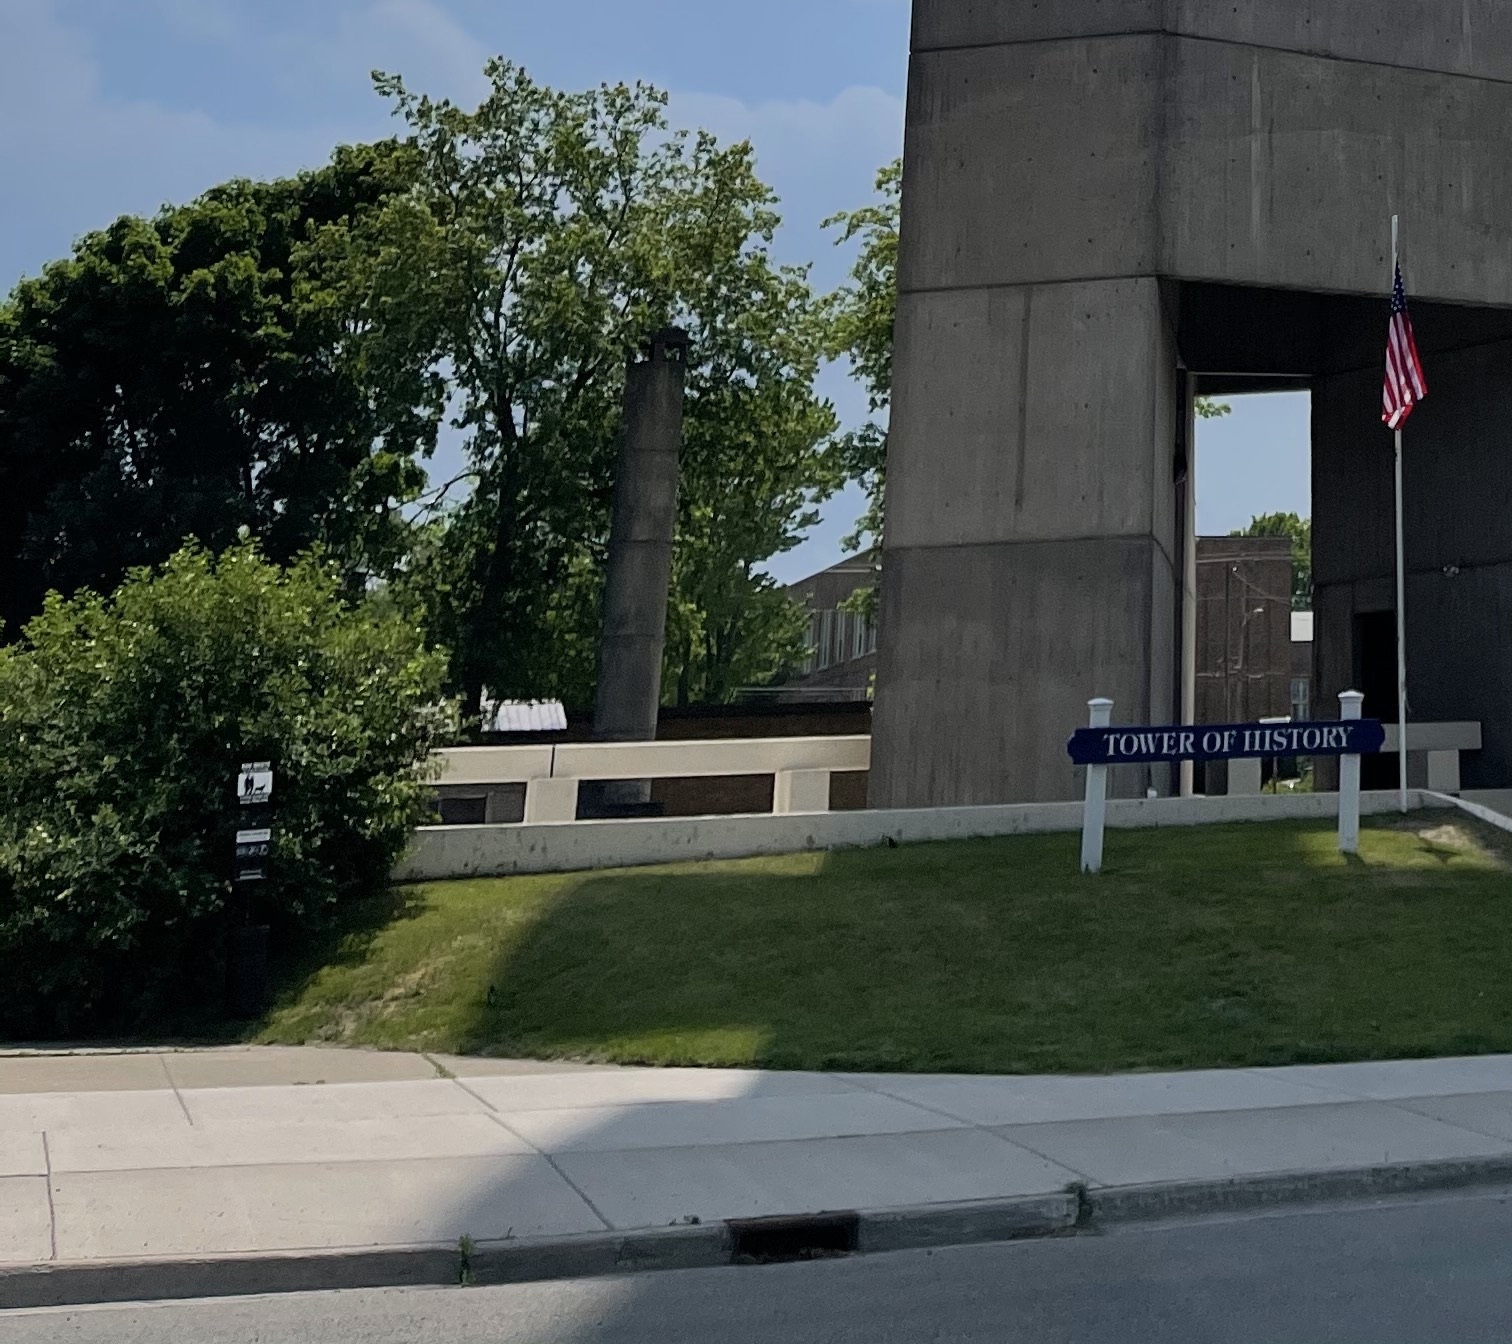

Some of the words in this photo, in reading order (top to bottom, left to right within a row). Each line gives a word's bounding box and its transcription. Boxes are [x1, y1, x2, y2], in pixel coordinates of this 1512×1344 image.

[1103, 731, 1195, 757] TOWER
[1202, 730, 1236, 753] OF
[1243, 725, 1354, 753] HISTORY
